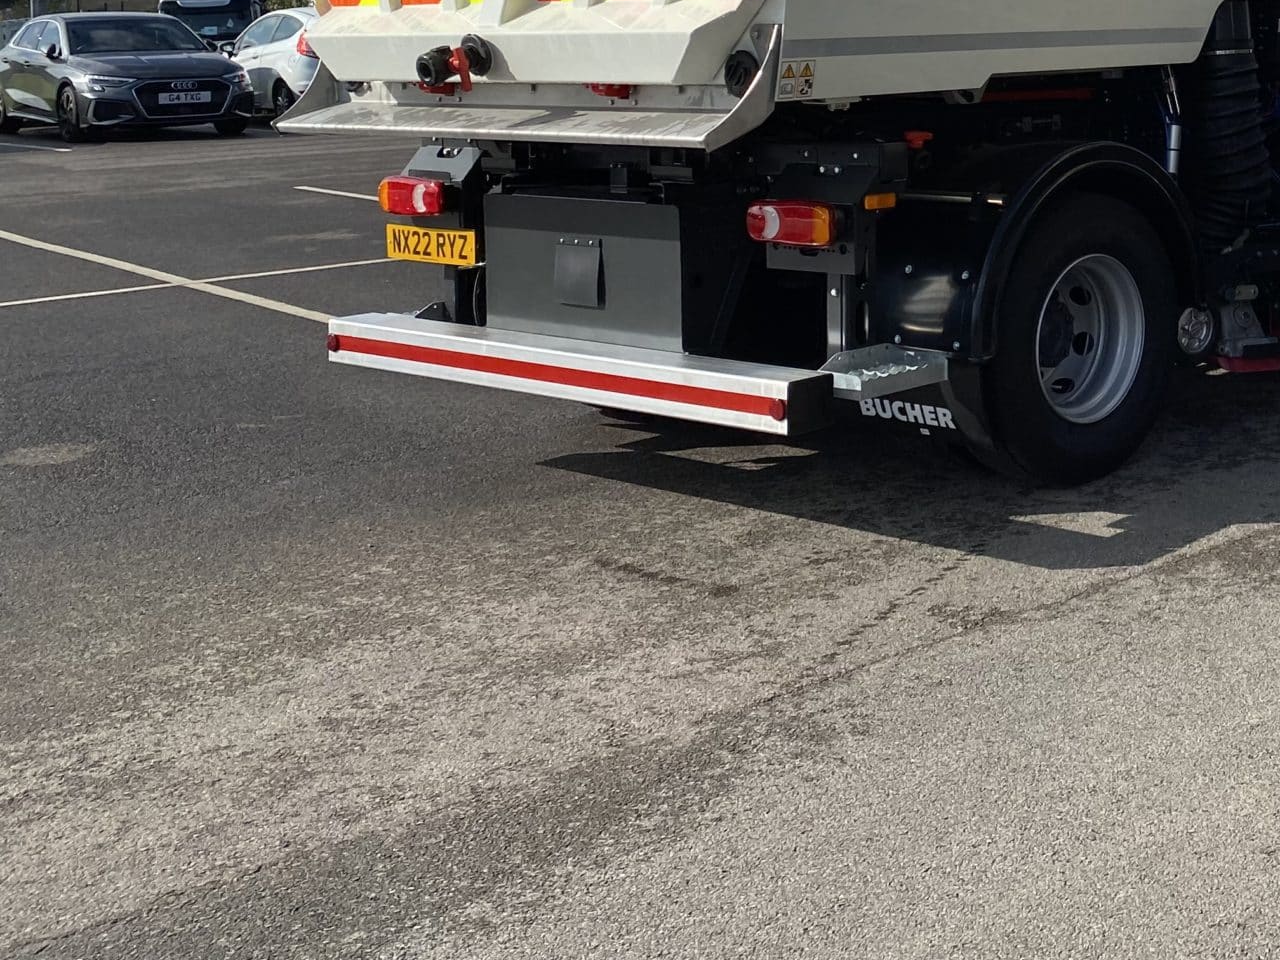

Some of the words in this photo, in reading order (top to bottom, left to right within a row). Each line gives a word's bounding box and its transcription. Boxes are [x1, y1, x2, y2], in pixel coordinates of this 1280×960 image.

[392, 228, 432, 256] NX22
[436, 232, 468, 260] RYZ
[860, 398, 957, 430] BUCHER
